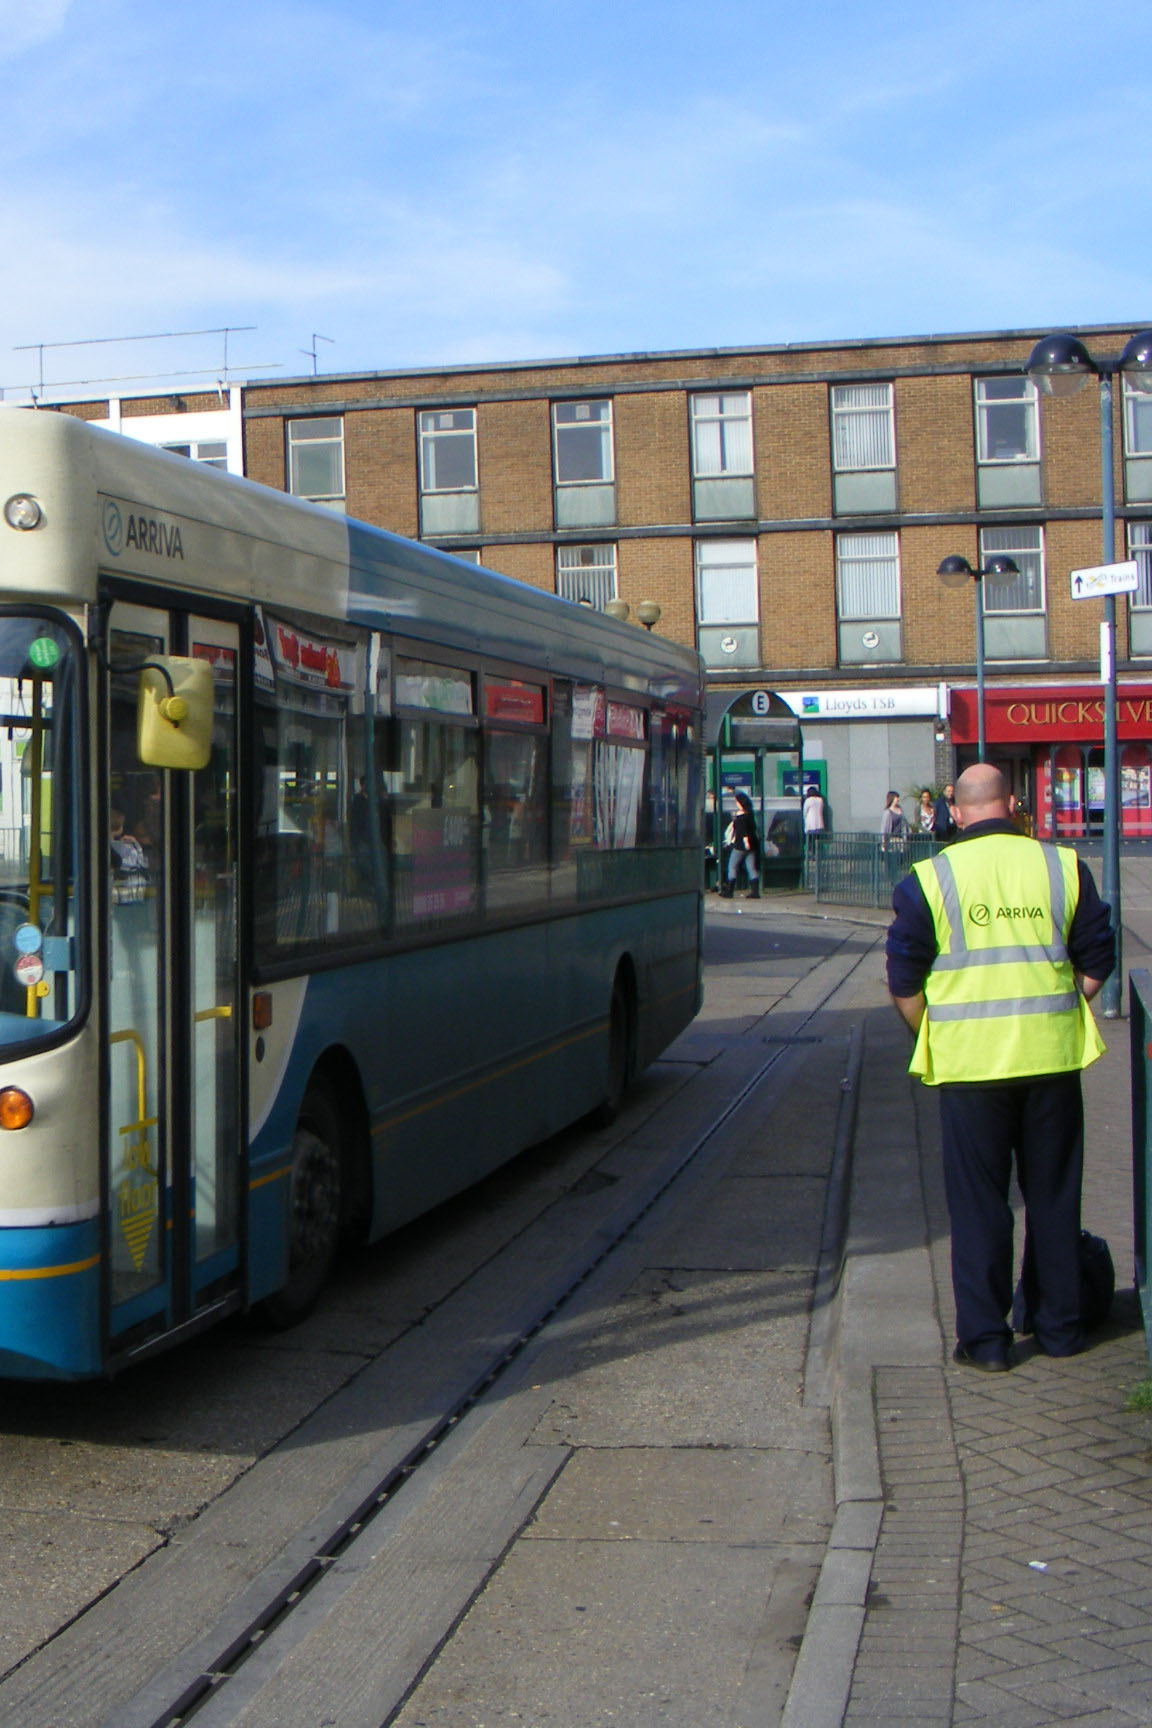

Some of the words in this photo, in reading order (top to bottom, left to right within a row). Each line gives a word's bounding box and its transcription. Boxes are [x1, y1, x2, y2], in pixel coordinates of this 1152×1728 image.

[126, 513, 184, 560] ARRIVA
[756, 695, 766, 712] E
[825, 699, 868, 714] Lloyds
[872, 697, 896, 709] TSB
[996, 907, 1044, 919] ARRIVA
